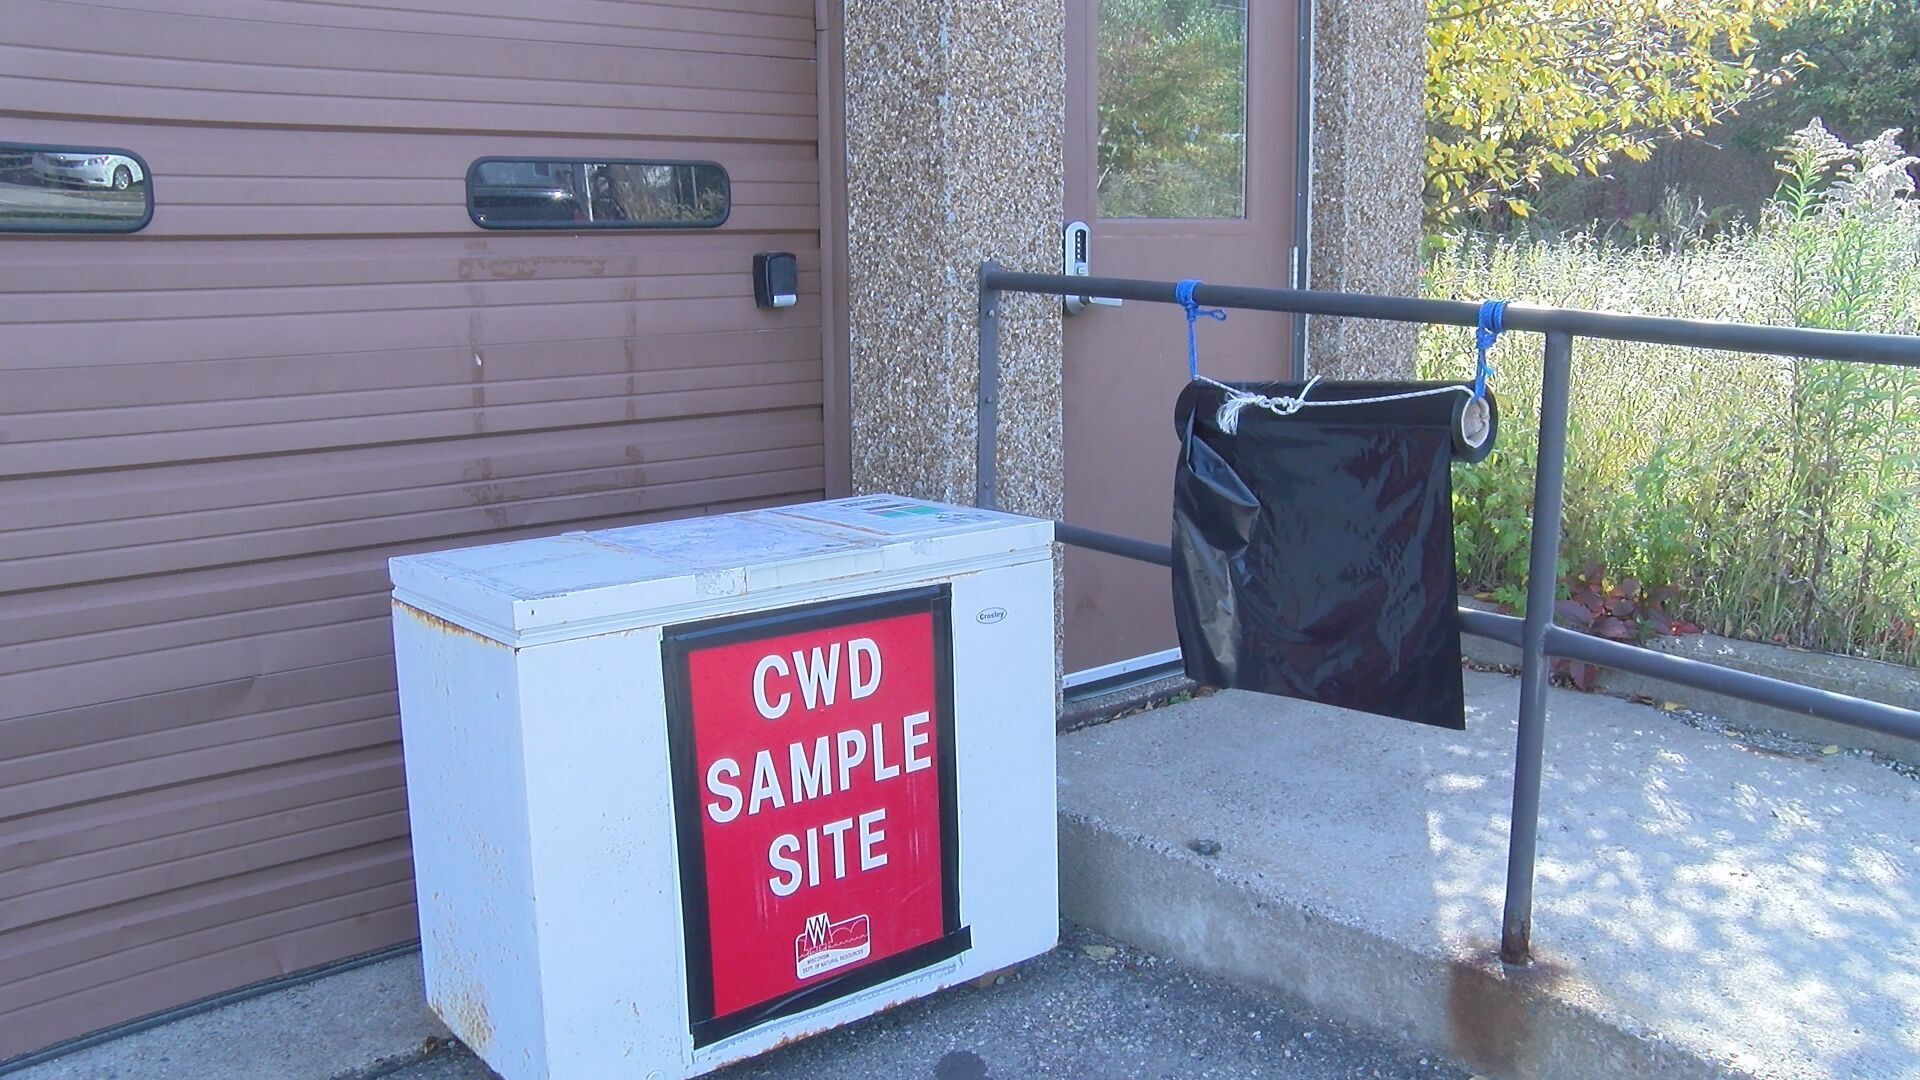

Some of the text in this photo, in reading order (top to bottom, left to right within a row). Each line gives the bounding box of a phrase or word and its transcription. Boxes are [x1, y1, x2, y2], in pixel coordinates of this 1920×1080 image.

[979, 610, 1005, 621] Crosley
[753, 637, 882, 720] CWD
[706, 710, 932, 823] SAMPLE
[768, 807, 888, 897] SITE
[807, 953, 830, 964] WISCONSIN
[820, 958, 839, 967] NATURAL
[839, 948, 864, 960] RESOURCES
